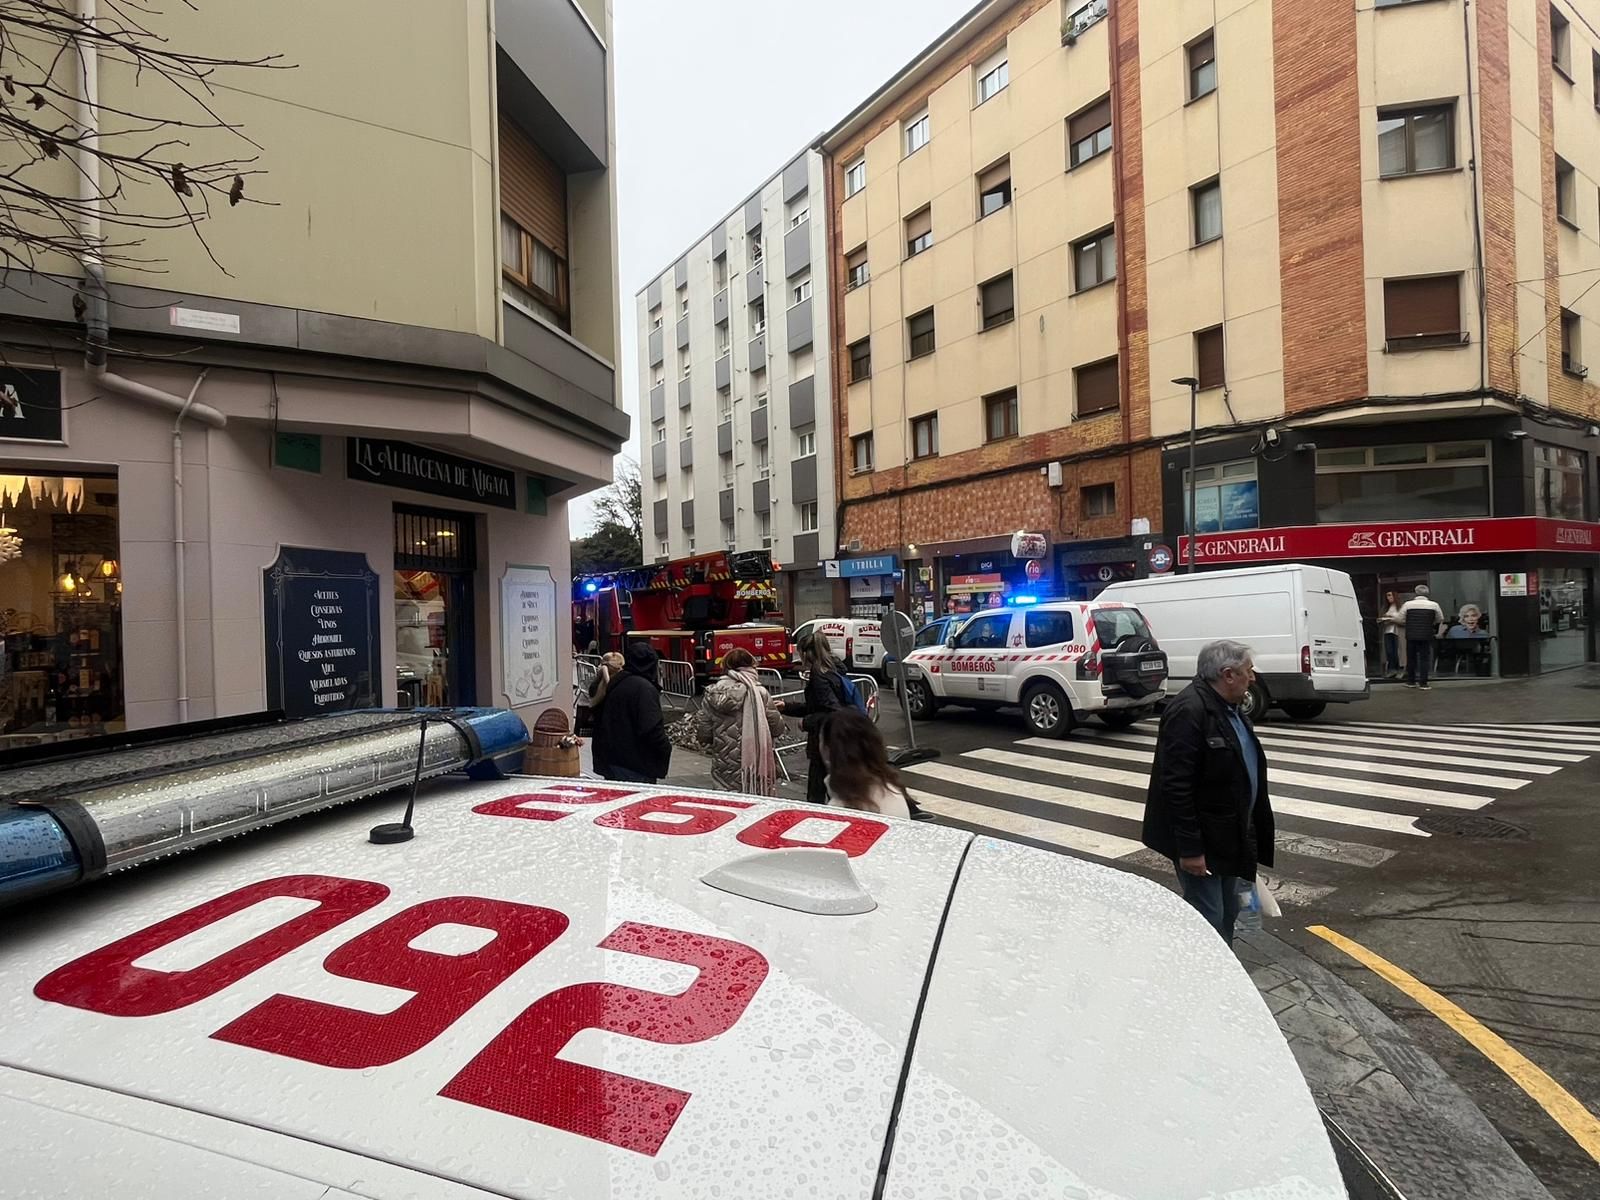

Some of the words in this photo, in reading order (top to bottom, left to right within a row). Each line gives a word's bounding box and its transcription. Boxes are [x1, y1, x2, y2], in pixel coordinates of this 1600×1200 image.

[355, 437, 382, 476] LA
[378, 445, 451, 483] ALHACENA
[454, 466, 470, 487] DE
[1377, 527, 1475, 548] GENERALI
[1205, 535, 1286, 556] GENERALI
[736, 589, 771, 597] BOMBEROS
[310, 604, 343, 617] CONSERVAS
[317, 618, 338, 629] VINOS
[1067, 644, 1086, 653] 080
[298, 649, 323, 662] QUESOS
[951, 660, 996, 672] BOMBEROS
[33, 873, 770, 1157] 092
